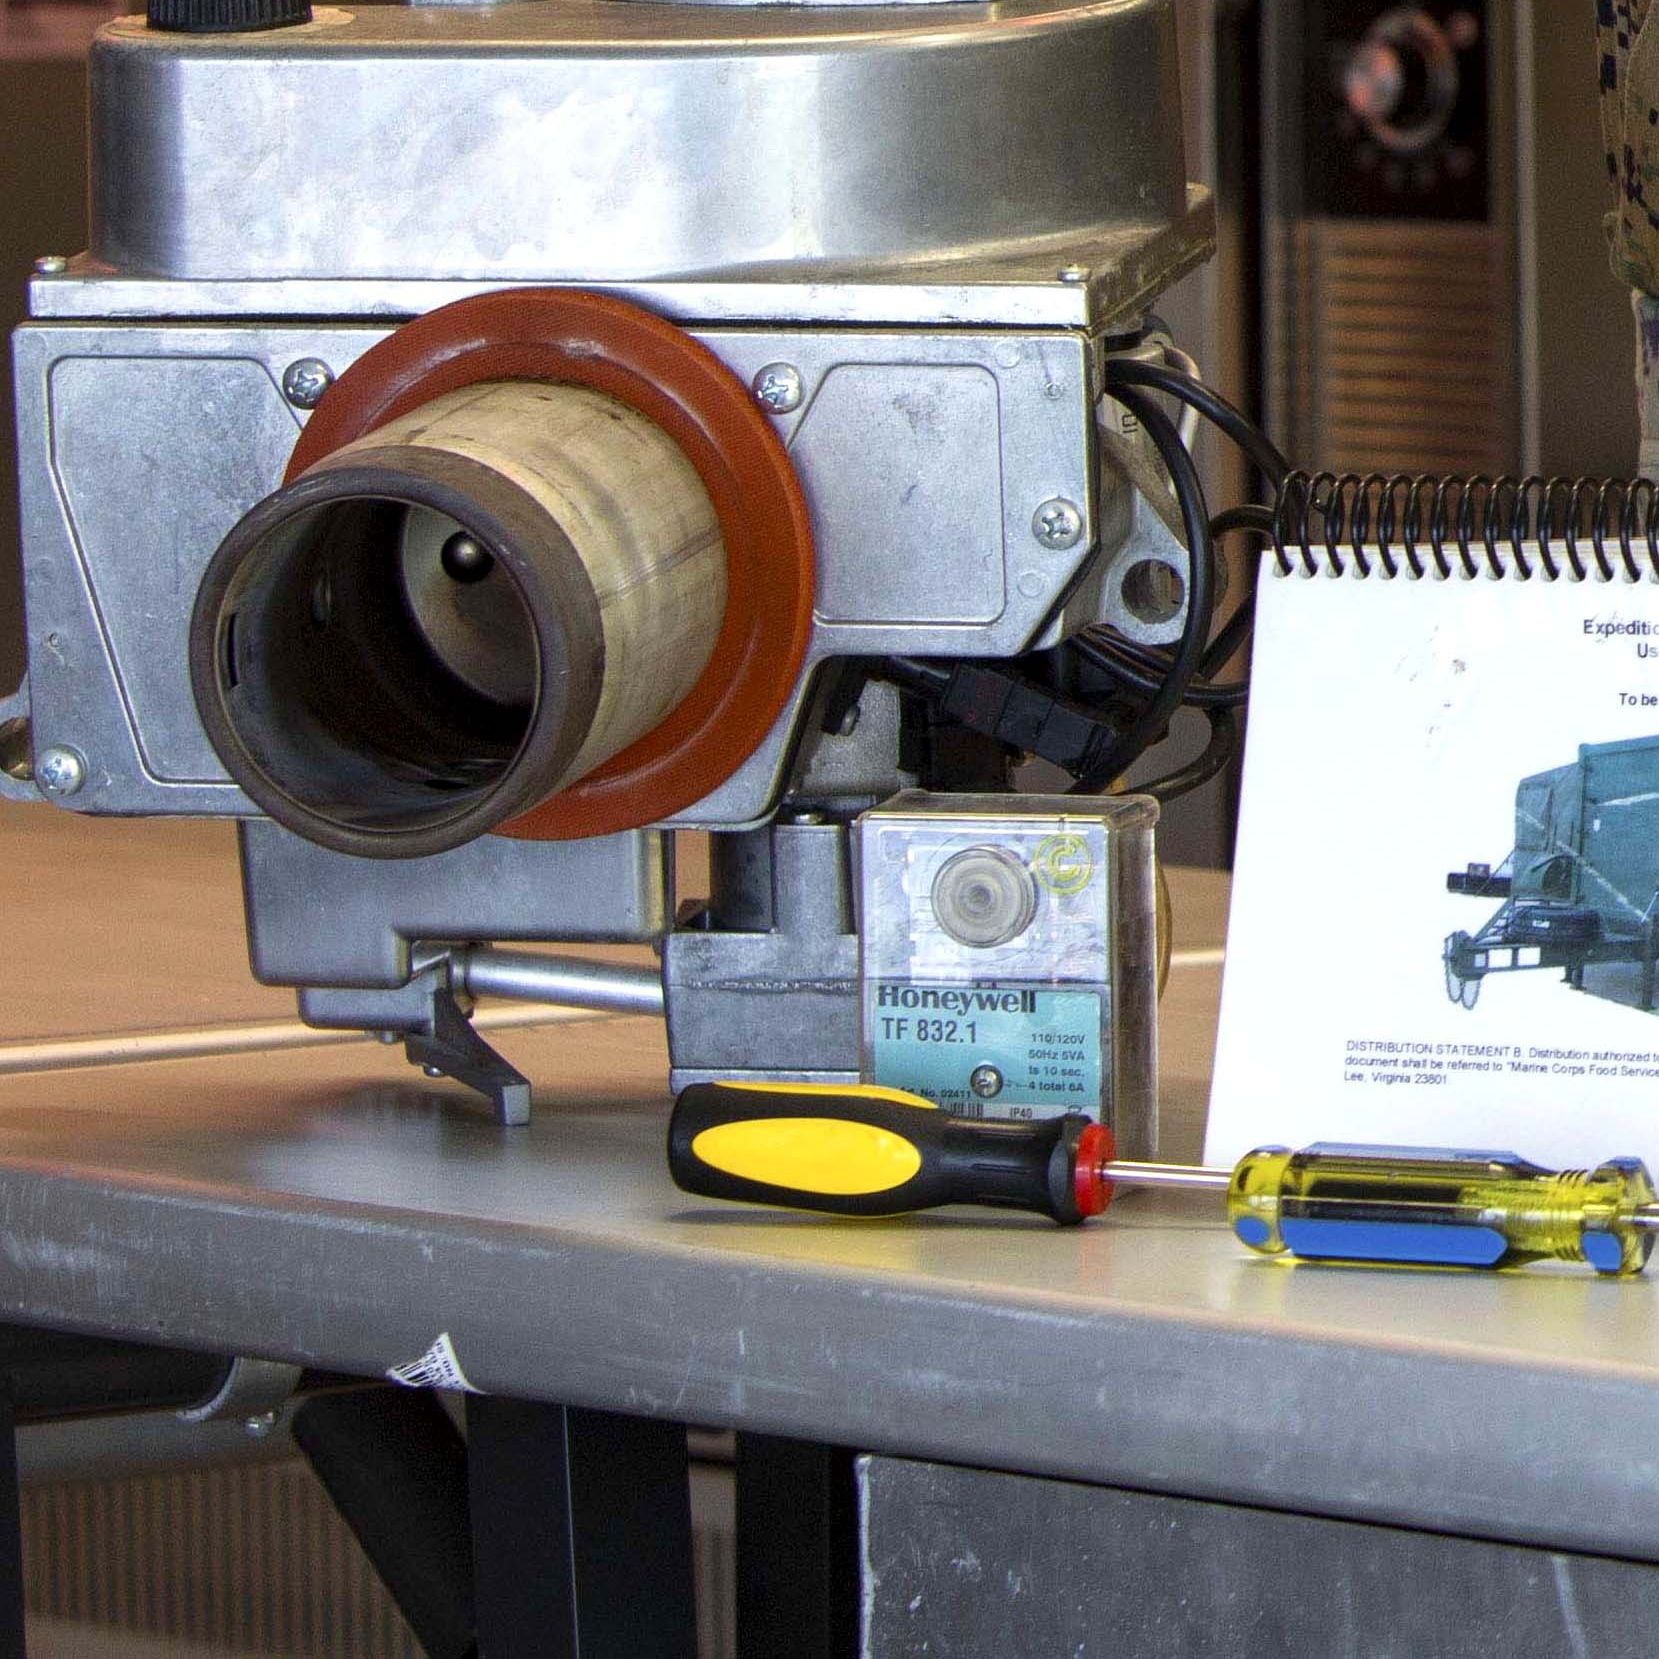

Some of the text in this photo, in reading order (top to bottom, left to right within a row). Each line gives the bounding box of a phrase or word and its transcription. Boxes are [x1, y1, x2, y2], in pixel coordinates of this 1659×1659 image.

[1619, 693, 1637, 706] To
[1641, 694, 1658, 706] be
[877, 985, 1036, 1015] Honeywell
[881, 1018, 977, 1043] TF 832.1
[1031, 1033, 1086, 1045] 110/120V
[1028, 1049, 1058, 1059] 50Hz
[1346, 1040, 1433, 1054] DISTRIBUTION
[1436, 1044, 1510, 1057] STATEMENT
[1529, 1047, 1590, 1060] Distribution
[1592, 1051, 1650, 1062] authorized
[1044, 1066, 1057, 1076] 10
[1345, 1054, 1398, 1066] document
[1402, 1058, 1427, 1069] shall
[1430, 1060, 1443, 1069] be
[1447, 1060, 1490, 1071] referred
[1493, 1061, 1503, 1071] to
[1552, 1063, 1585, 1076] Corps
[1589, 1064, 1617, 1075] Food
[1372, 1072, 1410, 1085] Virginia
